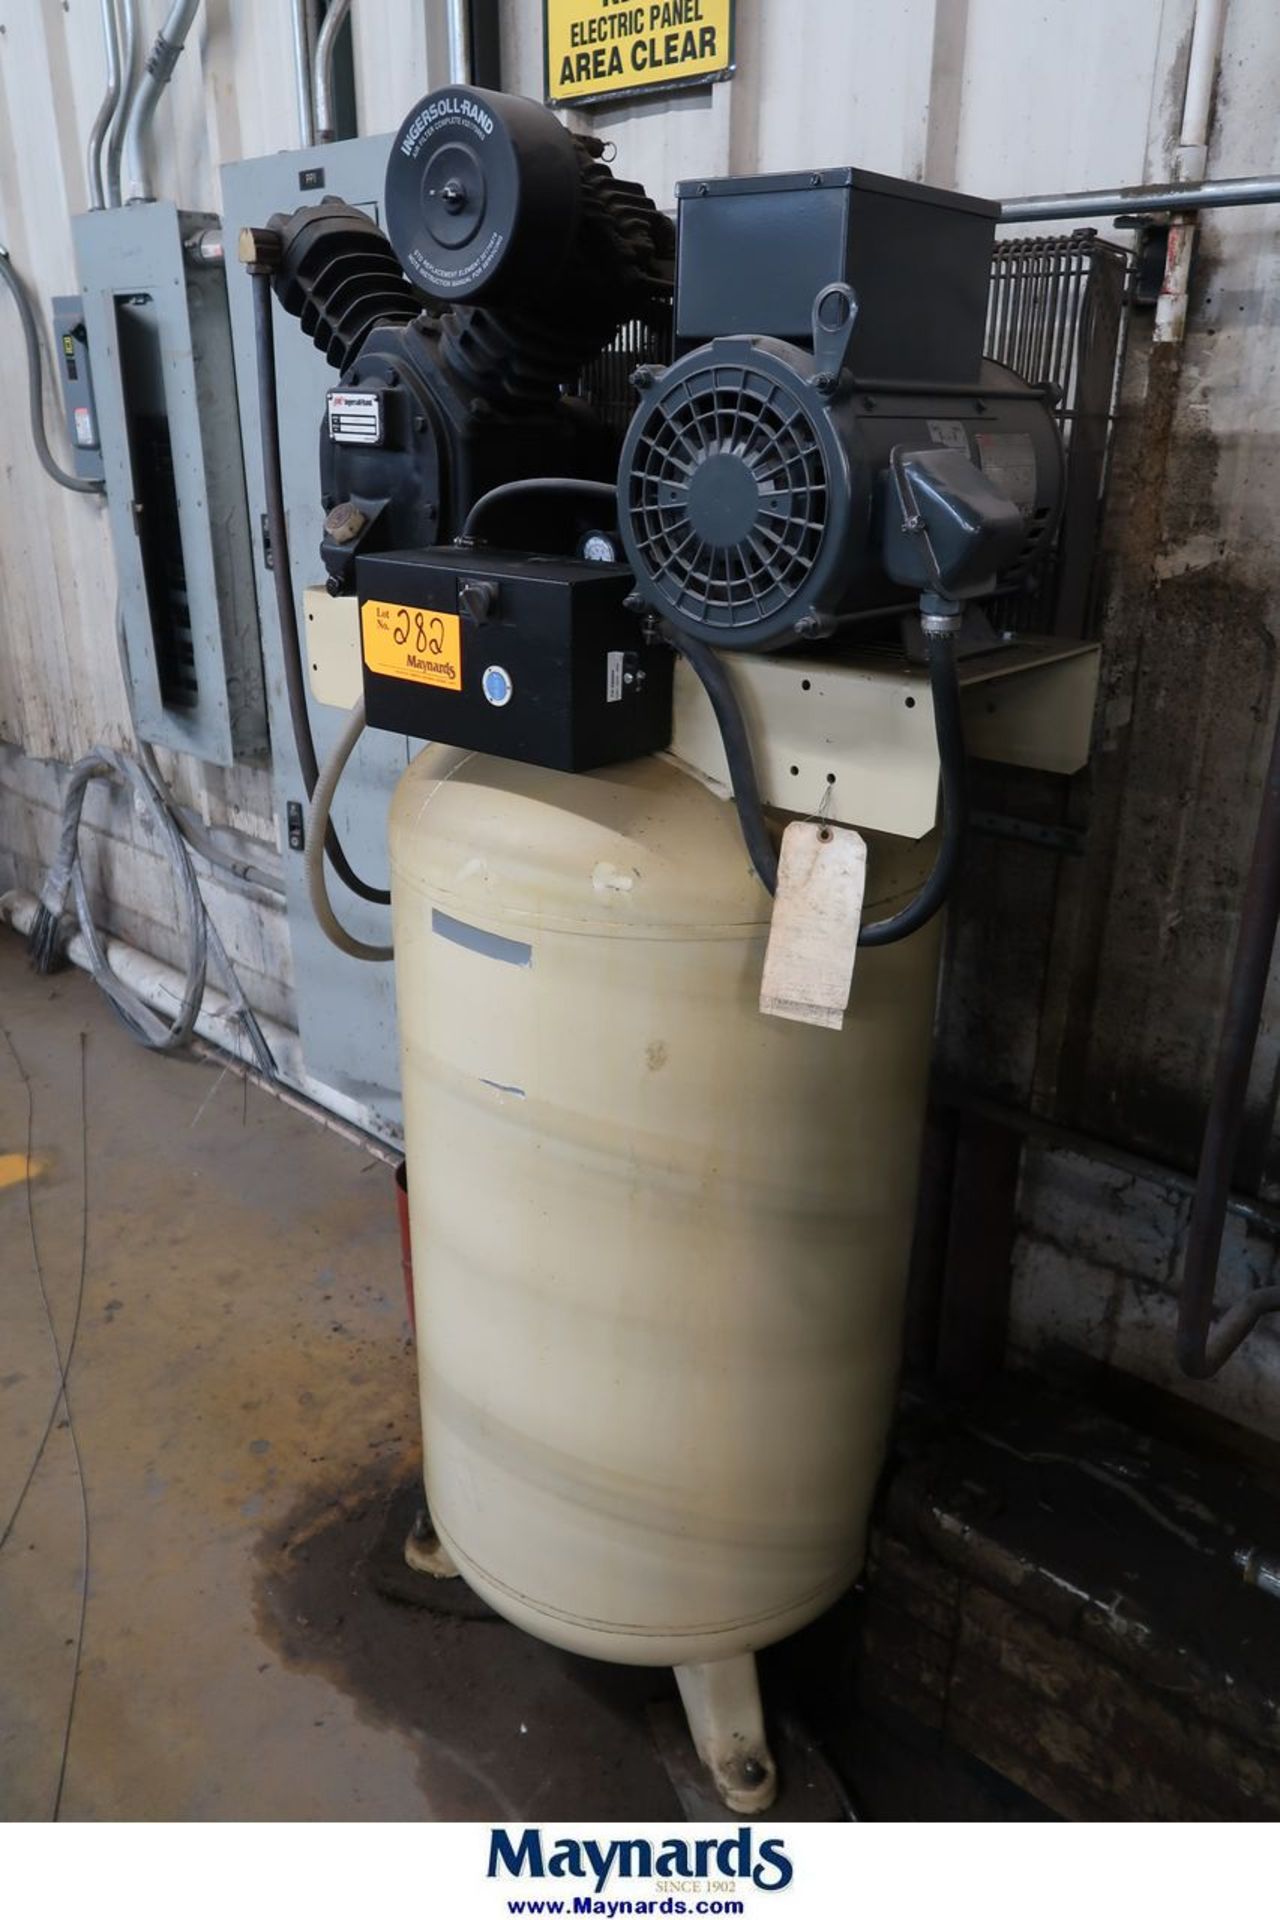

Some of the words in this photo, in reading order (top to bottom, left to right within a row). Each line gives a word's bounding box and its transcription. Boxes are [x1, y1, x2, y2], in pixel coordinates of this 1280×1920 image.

[571, 8, 645, 48] ELECTRIC
[650, 0, 703, 31] PANEL
[559, 46, 624, 85] AREA
[630, 26, 717, 72] CLEAR
[400, 98, 494, 156] INGERSOLL-RAND
[376, 607, 390, 619] Lot
[393, 609, 445, 655] 282
[406, 654, 456, 680] Maynards
